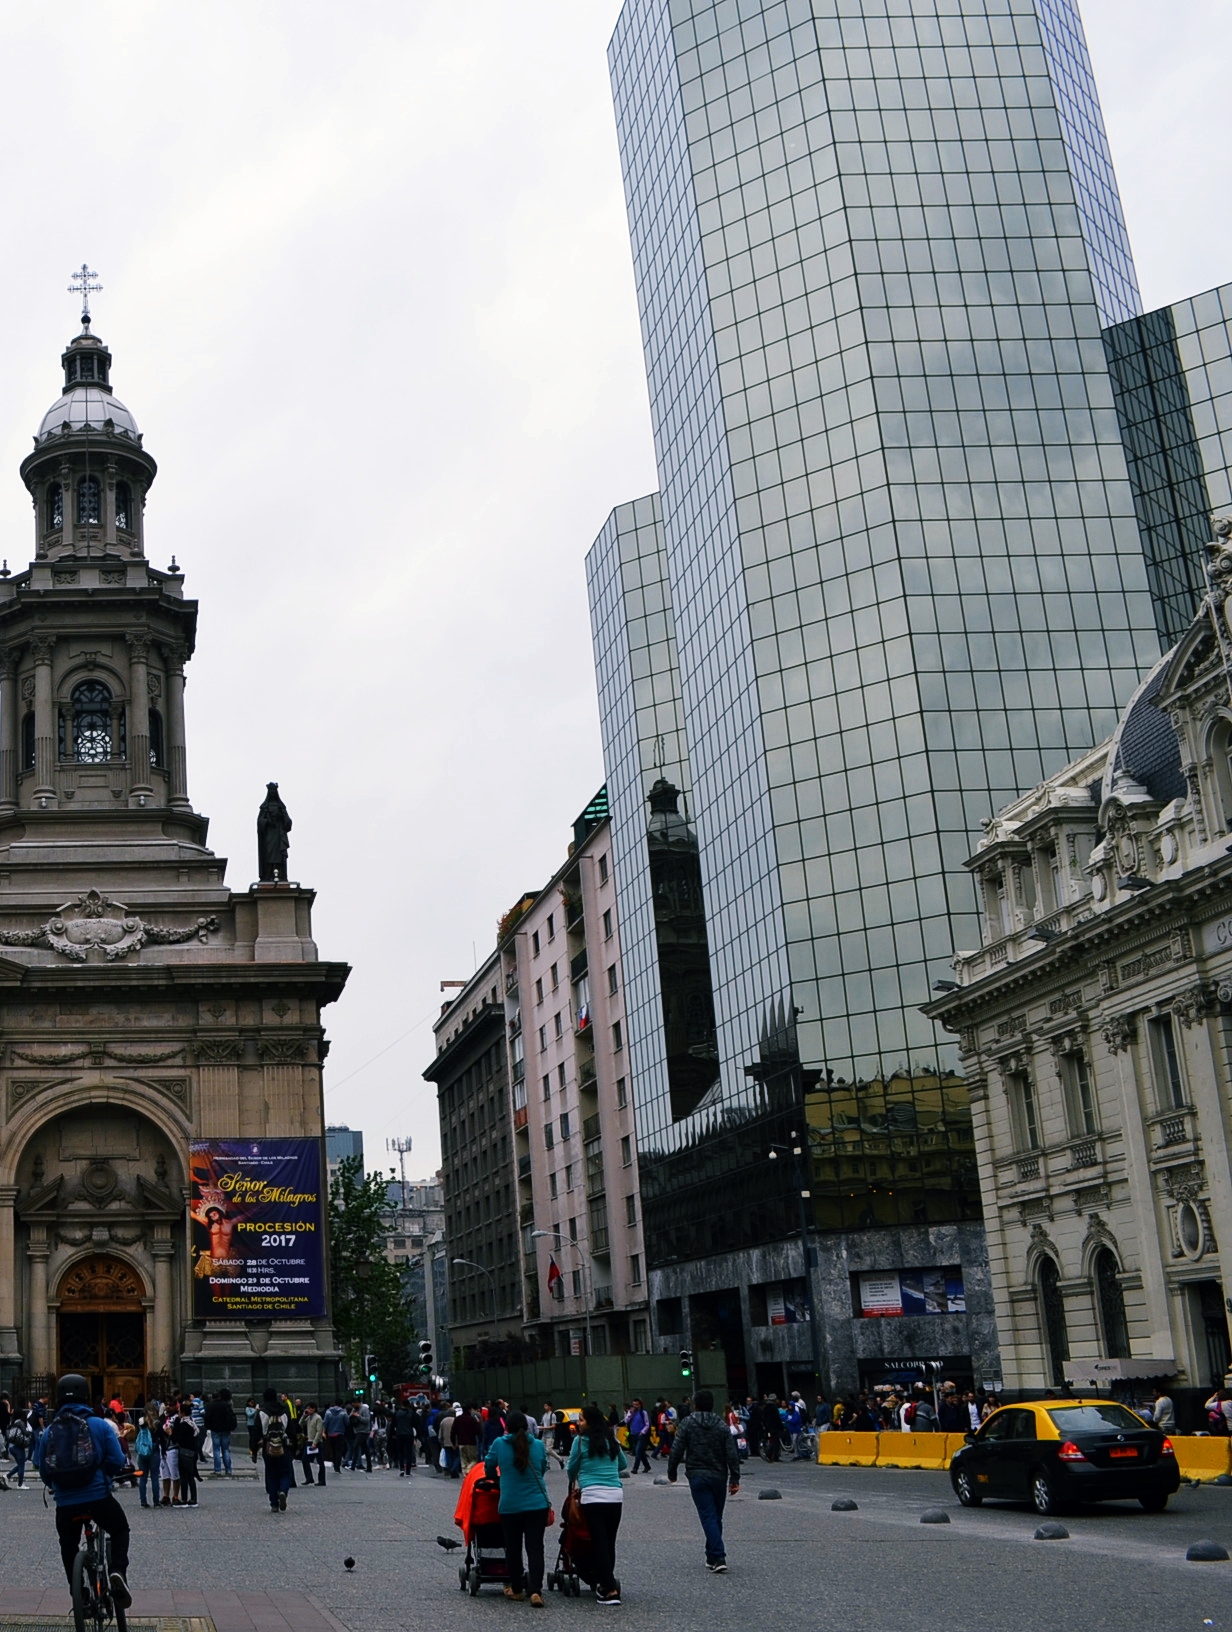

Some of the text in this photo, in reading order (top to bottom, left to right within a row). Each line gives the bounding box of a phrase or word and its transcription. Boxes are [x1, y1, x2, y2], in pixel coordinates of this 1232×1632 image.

[218, 1171, 267, 1191] Señor
[232, 1186, 317, 1207] de los Milagros
[237, 1220, 315, 1232] PROCESIÓN
[261, 1234, 296, 1247] 2017
[212, 1257, 244, 1266] SÁBADO
[258, 1266, 276, 1274] HRS.
[272, 1276, 310, 1284] OCTUBRE
